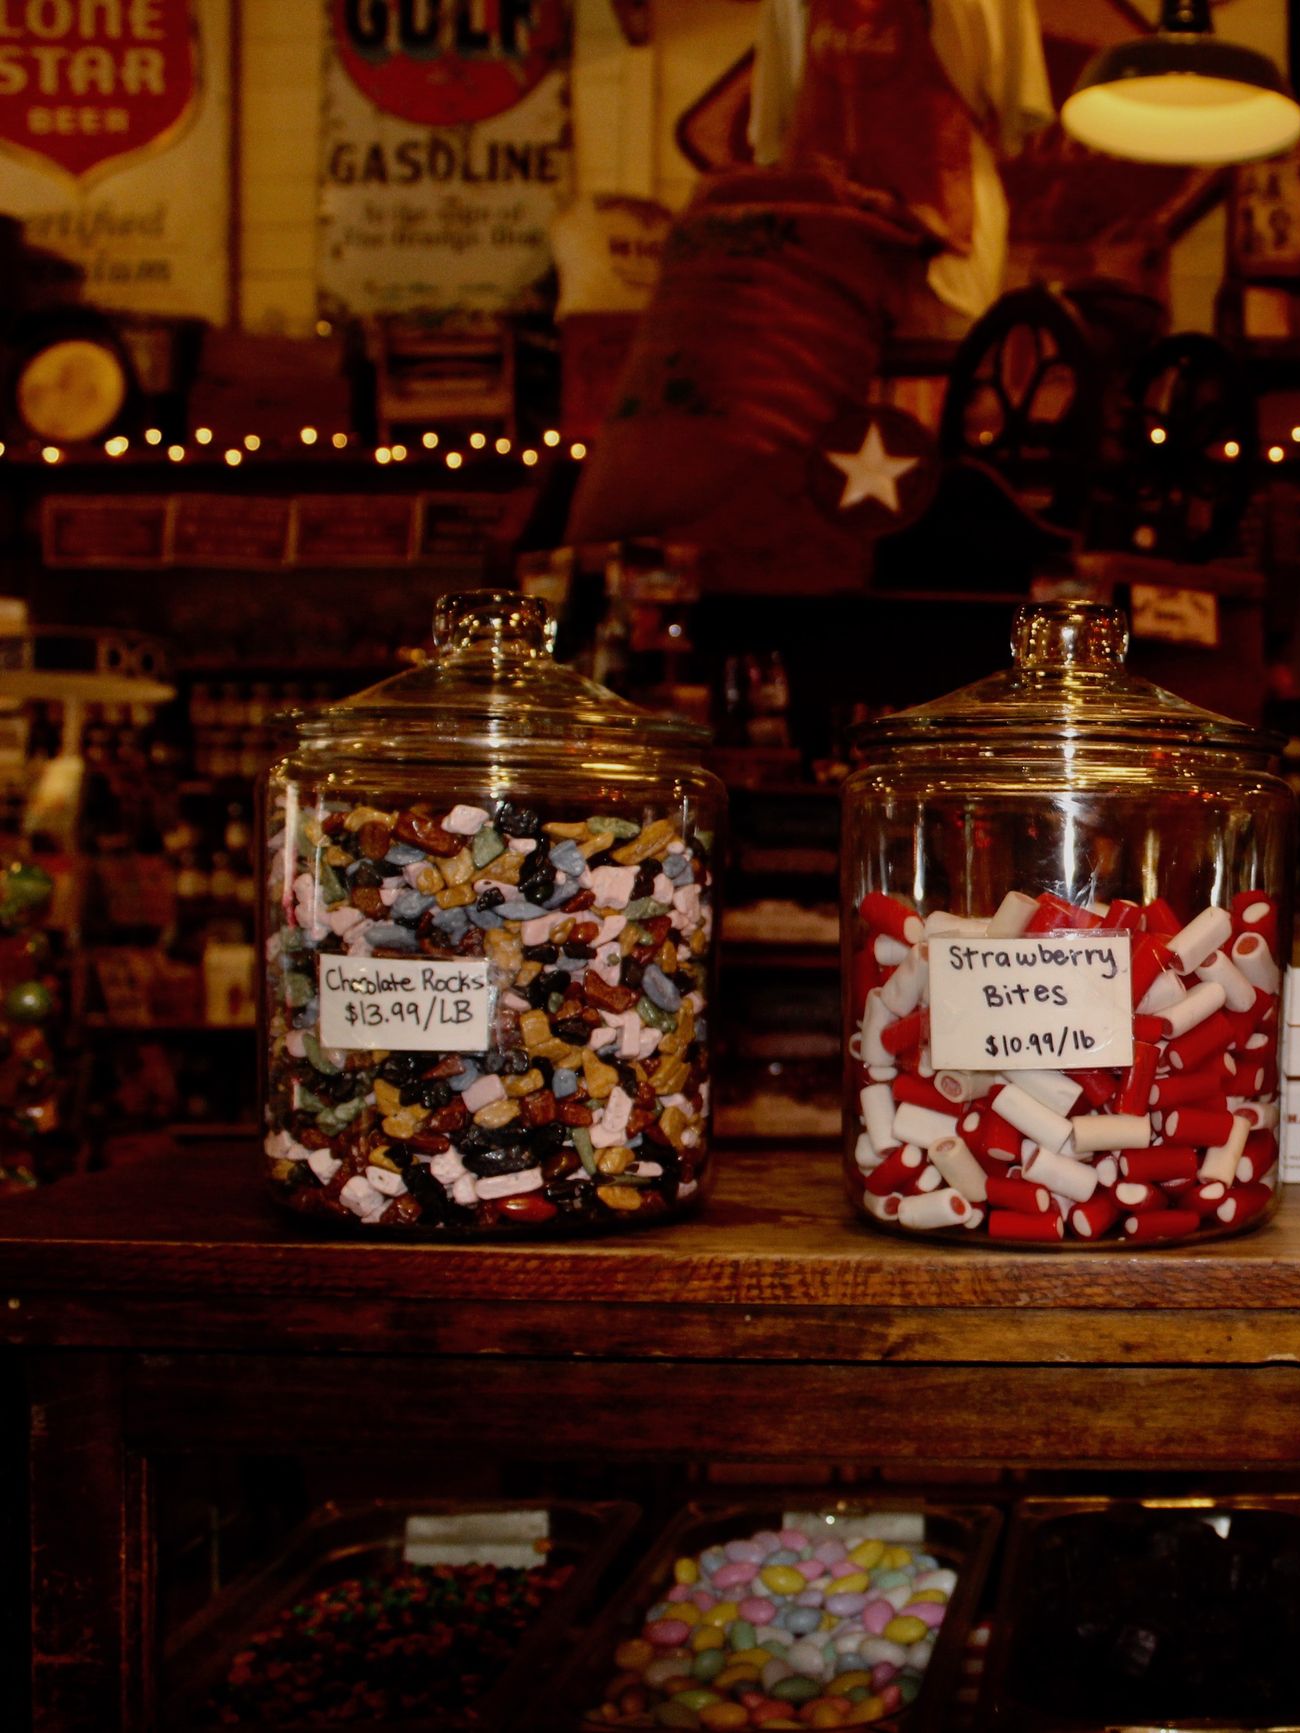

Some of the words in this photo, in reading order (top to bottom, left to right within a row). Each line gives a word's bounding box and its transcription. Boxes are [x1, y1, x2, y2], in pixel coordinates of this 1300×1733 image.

[0, 45, 166, 96] STAR
[26, 105, 131, 136] BEER
[329, 141, 560, 184] GASOLINE
[949, 944, 1118, 979] Strawberry
[325, 965, 416, 995] Chocolate
[421, 968, 485, 993] Rocks
[982, 983, 1068, 1007] Bites
[985, 1026, 1096, 1057] $10.99/lb
